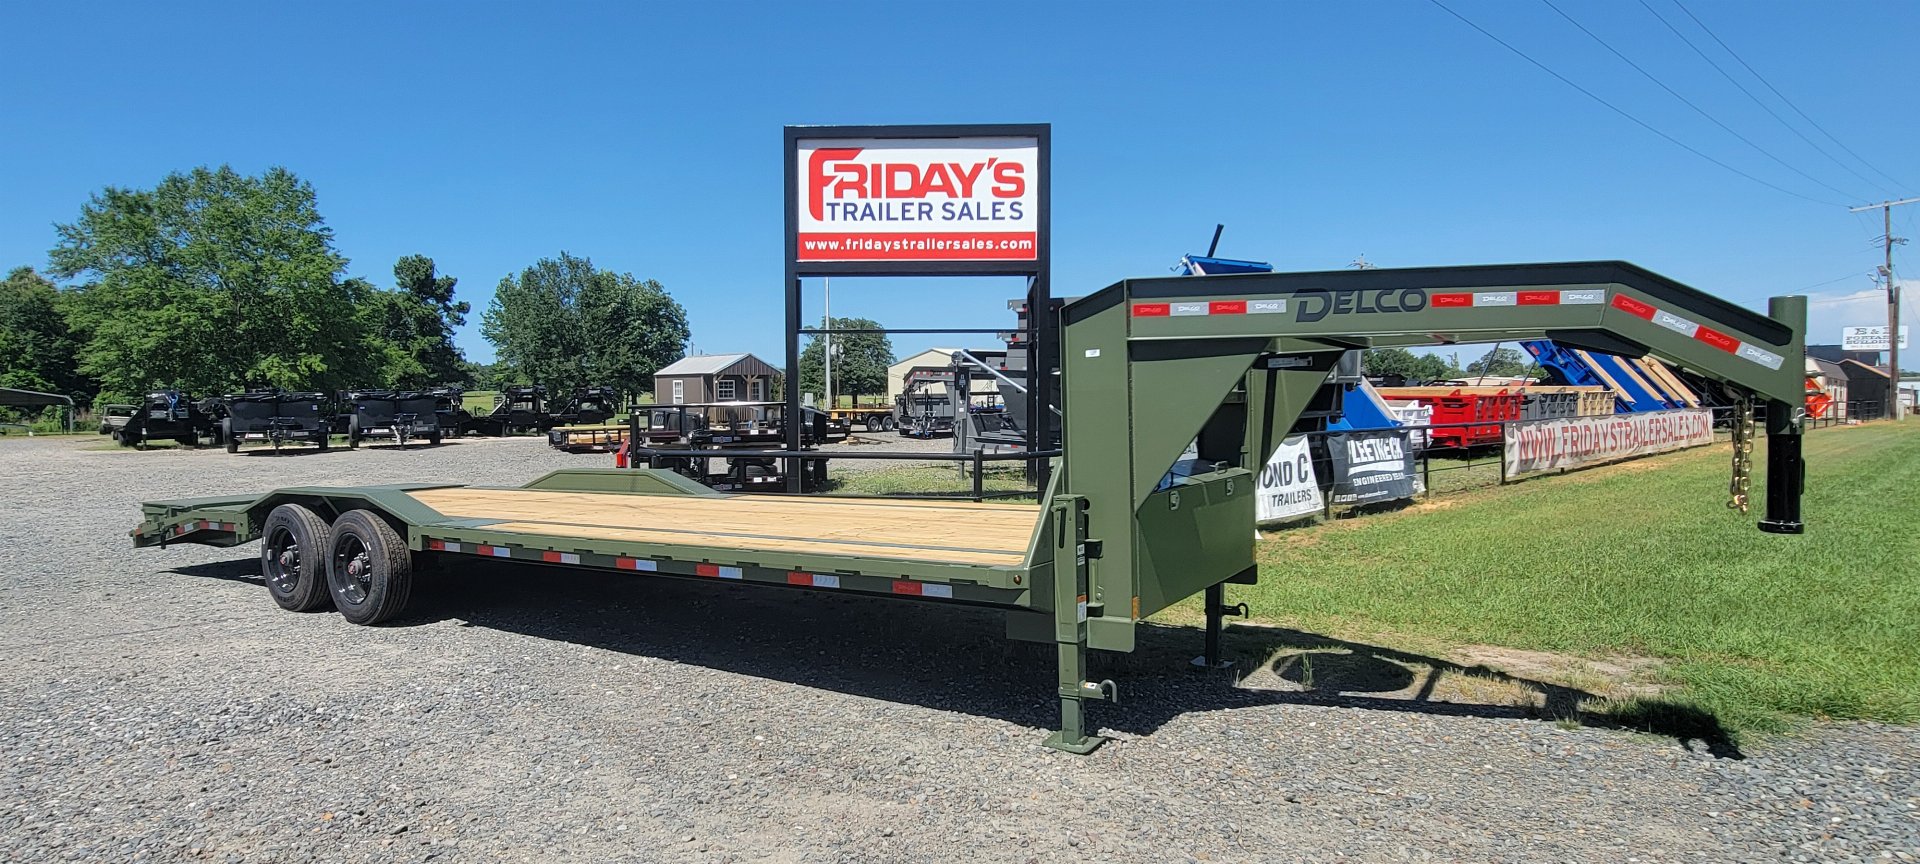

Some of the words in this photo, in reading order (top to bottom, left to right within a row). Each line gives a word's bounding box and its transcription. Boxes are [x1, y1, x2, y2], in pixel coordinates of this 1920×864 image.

[808, 147, 1026, 222] FRIDAY'S
[826, 202, 934, 221] TRAILER
[942, 201, 1024, 220] SALES
[804, 238, 1032, 252] www.fridaystrailersales.com
[1292, 287, 1427, 323] DELCO
[1256, 461, 1293, 490] OND
[1297, 453, 1309, 483] C
[1272, 489, 1312, 507] TRAILERS
